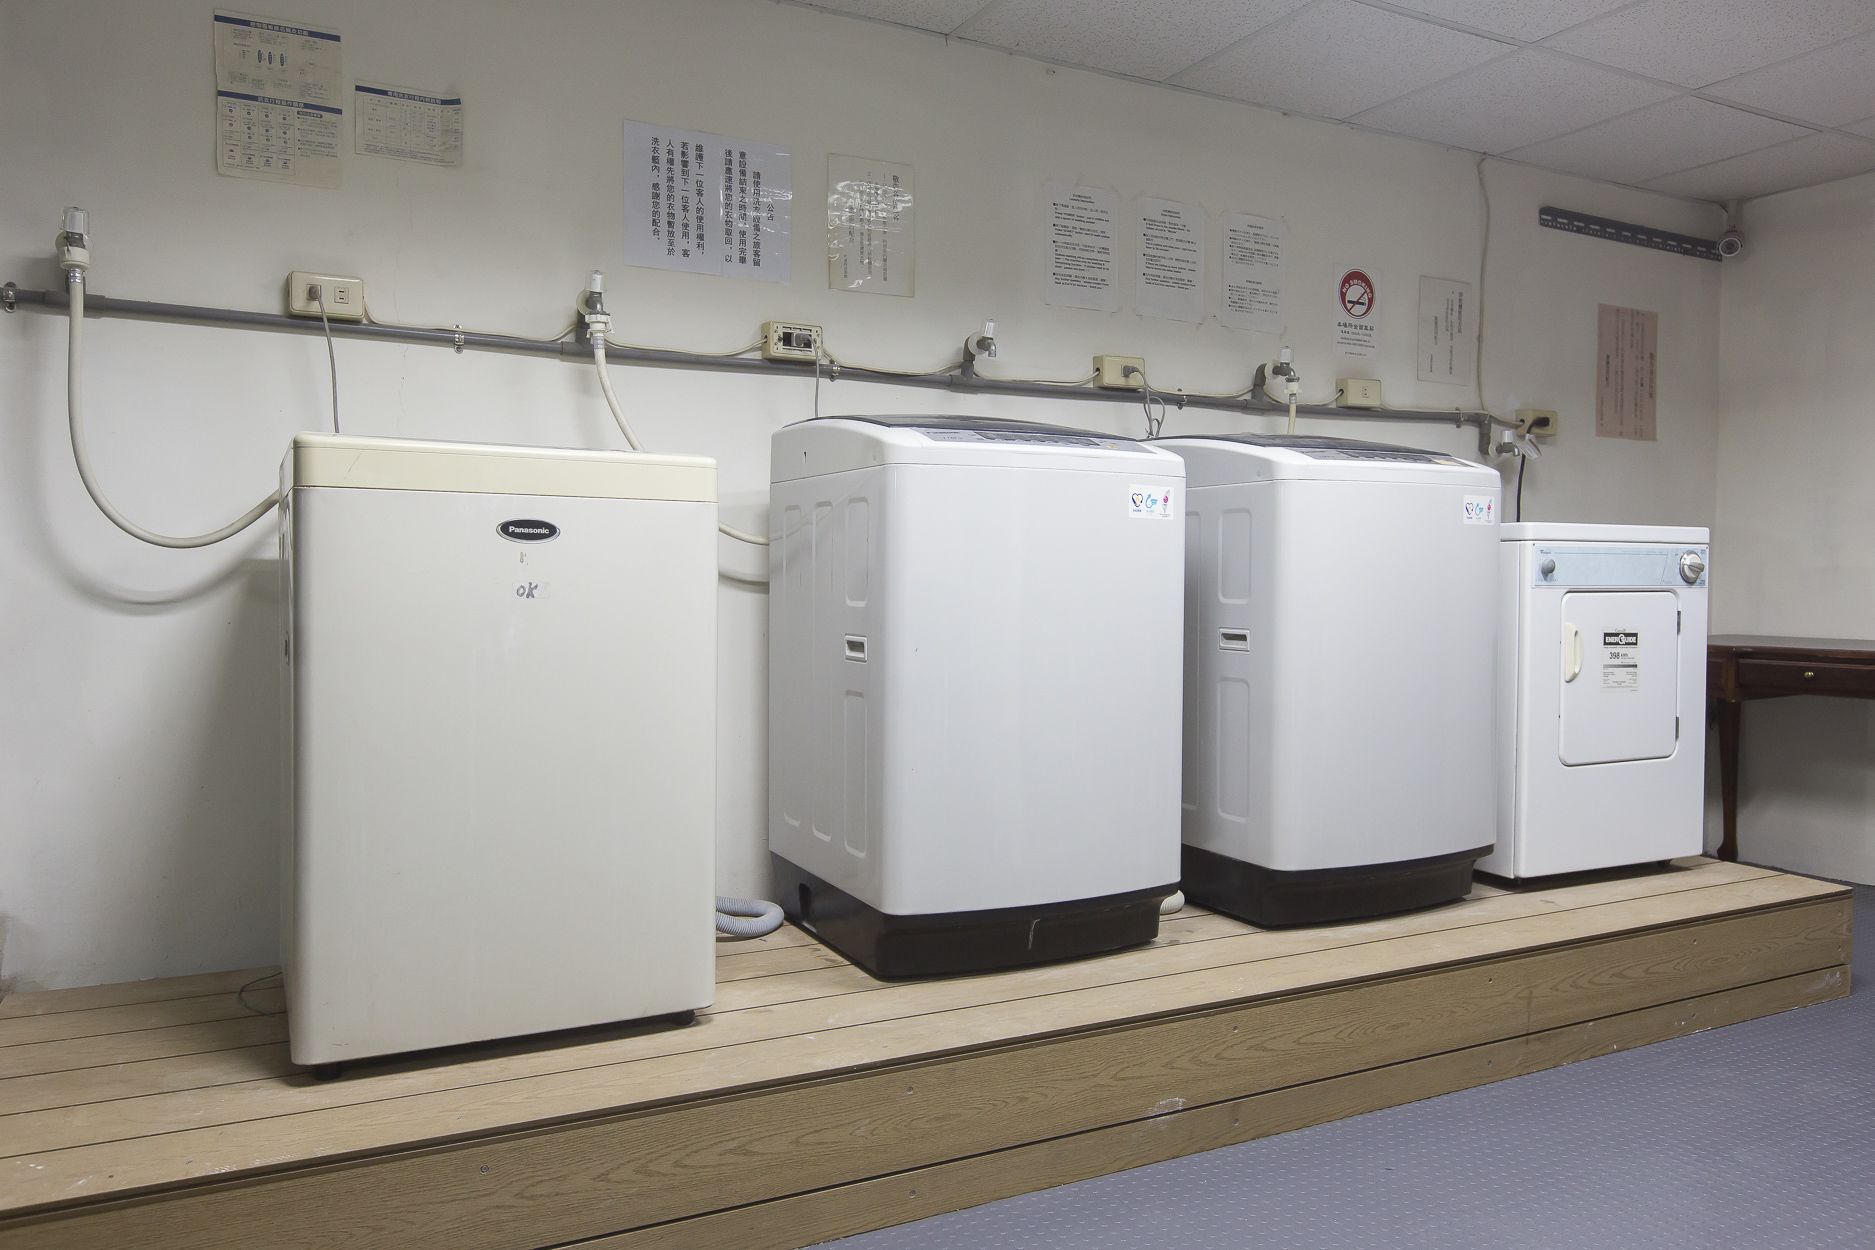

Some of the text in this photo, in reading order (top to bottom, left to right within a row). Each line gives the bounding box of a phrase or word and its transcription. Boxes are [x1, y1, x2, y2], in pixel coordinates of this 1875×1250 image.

[766, 203, 775, 221] 公告
[1342, 279, 1373, 299] NO SMOKING
[509, 526, 550, 534] Panasonic
[1609, 651, 1620, 660] 398
